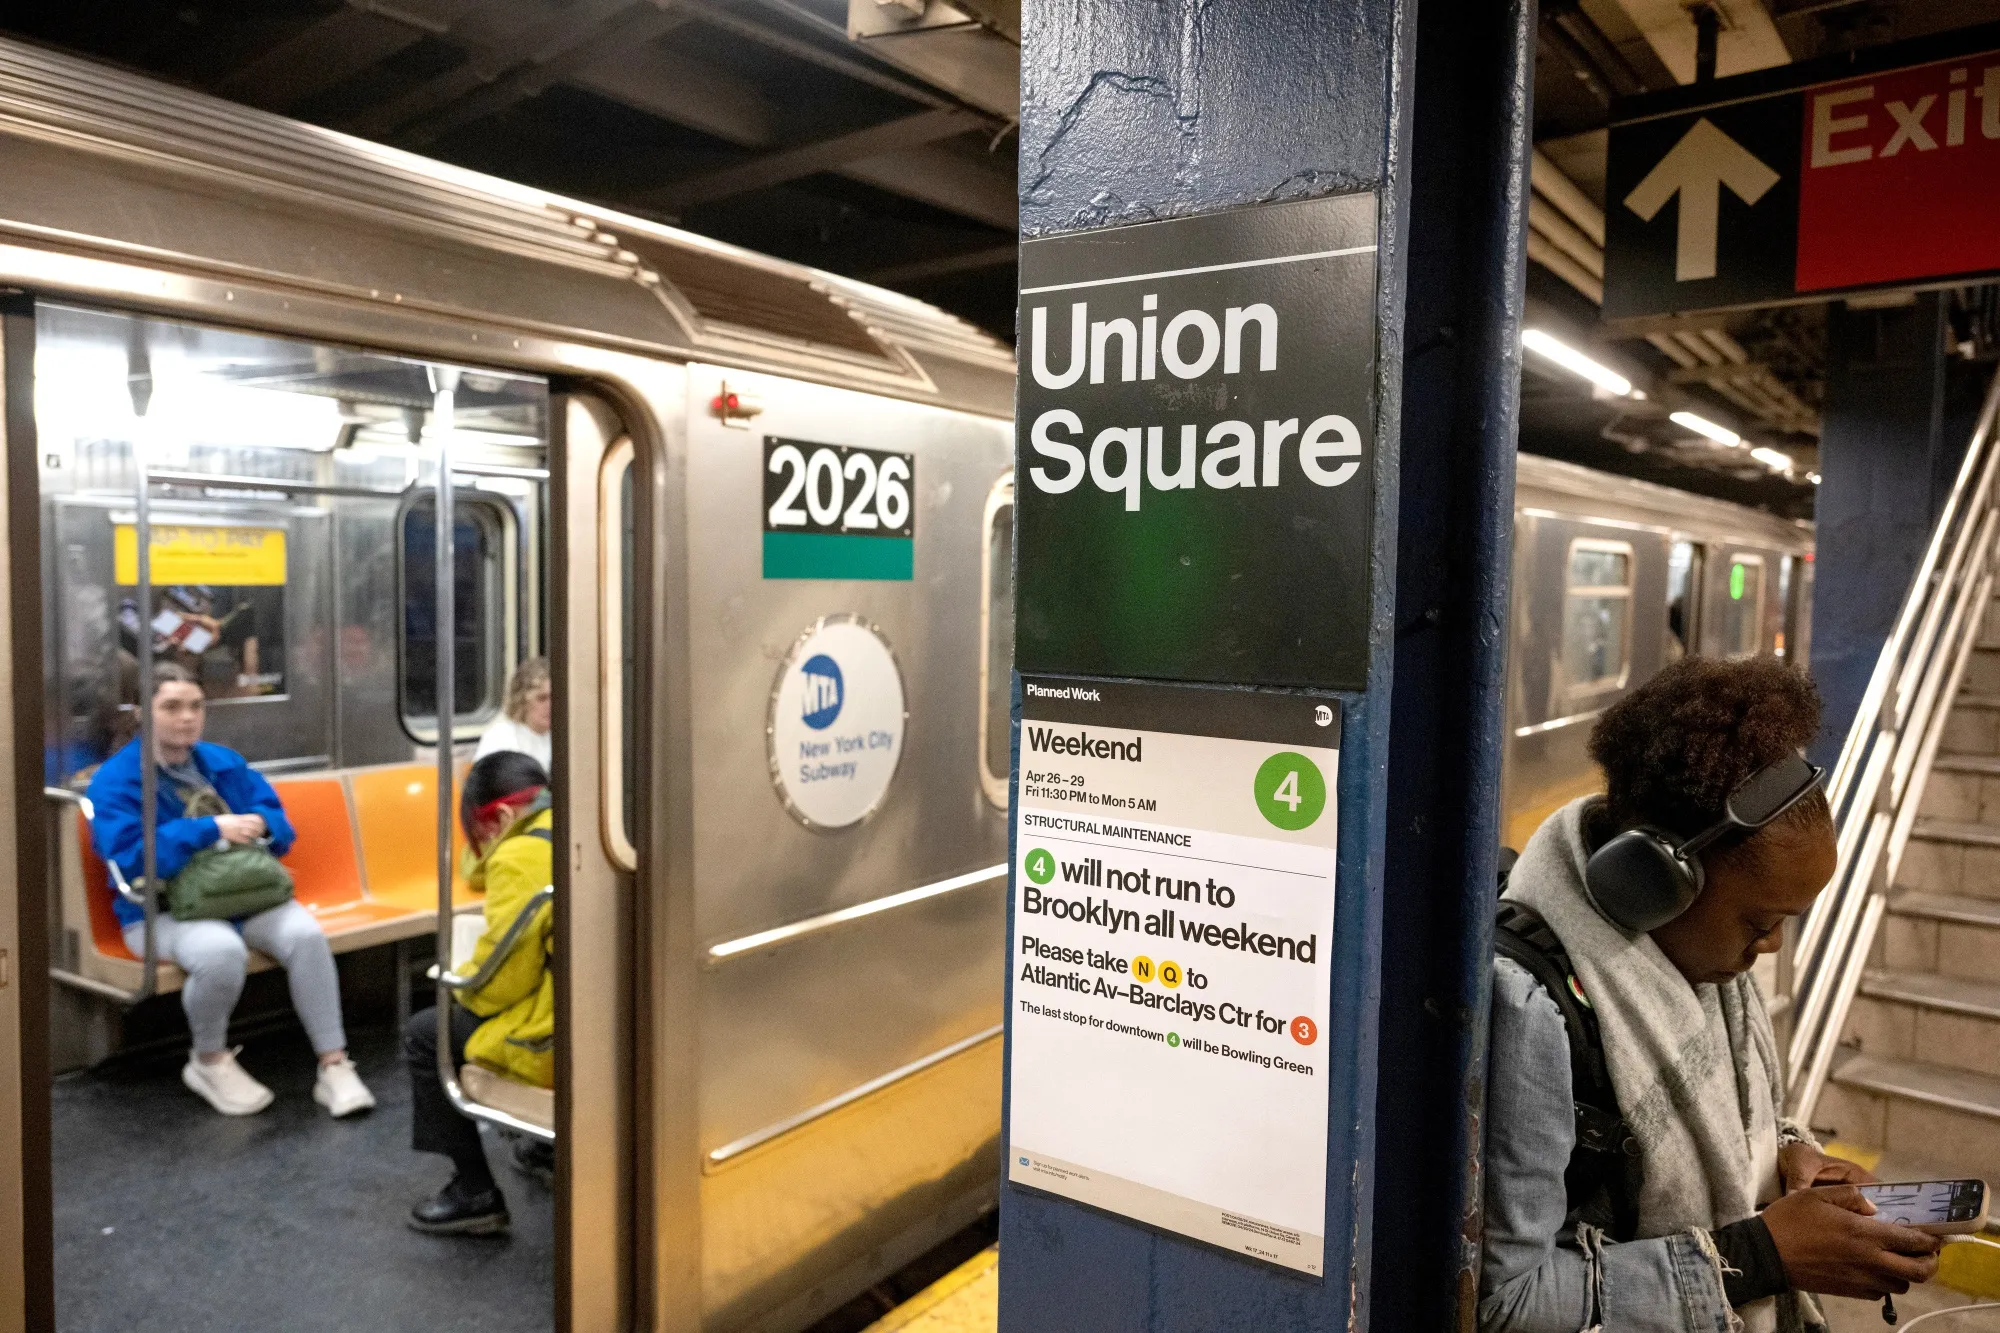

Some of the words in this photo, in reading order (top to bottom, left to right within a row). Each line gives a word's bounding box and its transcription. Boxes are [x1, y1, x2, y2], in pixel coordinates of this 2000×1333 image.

[1811, 66, 2000, 168] Exit
[1031, 294, 1278, 390] Union
[1030, 408, 1362, 511] Square
[769, 445, 910, 529] 2026
[1026, 684, 1070, 699] Planned
[1072, 688, 1100, 701] Work
[800, 741, 830, 758] New
[834, 735, 864, 752] York
[868, 731, 893, 750] City
[1028, 726, 1142, 762] Weekend
[800, 761, 856, 783] Subway
[1026, 770, 1045, 783] Apr
[1026, 785, 1039, 797] Fri
[1041, 788, 1067, 800] 11:30
[1069, 790, 1086, 803] PM
[1089, 793, 1099, 804] to
[1102, 794, 1126, 807] Mon
[1128, 798, 1135, 808] 5
[1137, 800, 1156, 811] AM
[1273, 771, 1302, 812] 4
[1024, 814, 1100, 835] STRUCTURAL
[1102, 824, 1192, 848] MAINTENANCE
[1033, 856, 1046, 876] 4
[1061, 858, 1101, 887] will
[1106, 867, 1150, 895] not
[1155, 877, 1201, 903] run
[1206, 878, 1235, 908] to
[1023, 886, 1139, 933] Brooklyn
[1145, 910, 1174, 938] all
[1179, 919, 1317, 964] weekend
[1022, 935, 1084, 965] Please
[1087, 948, 1128, 973] take
[1138, 963, 1149, 977] N
[1164, 967, 1177, 983] Q
[1187, 968, 1208, 990] to
[1021, 963, 1091, 994] Atlantic
[1219, 1002, 1252, 1026] Ctr
[1256, 1010, 1287, 1035] for
[1299, 1023, 1309, 1038] 3
[1020, 1000, 1041, 1014] The
[1042, 1005, 1061, 1019] last
[1063, 1011, 1087, 1026] stop
[1089, 1015, 1104, 1028] for
[1106, 1020, 1164, 1042] downtown
[1183, 1038, 1201, 1051] will
[1204, 1041, 1219, 1054] be
[1222, 1045, 1271, 1068] Bowling
[1274, 1056, 1314, 1076] Green
